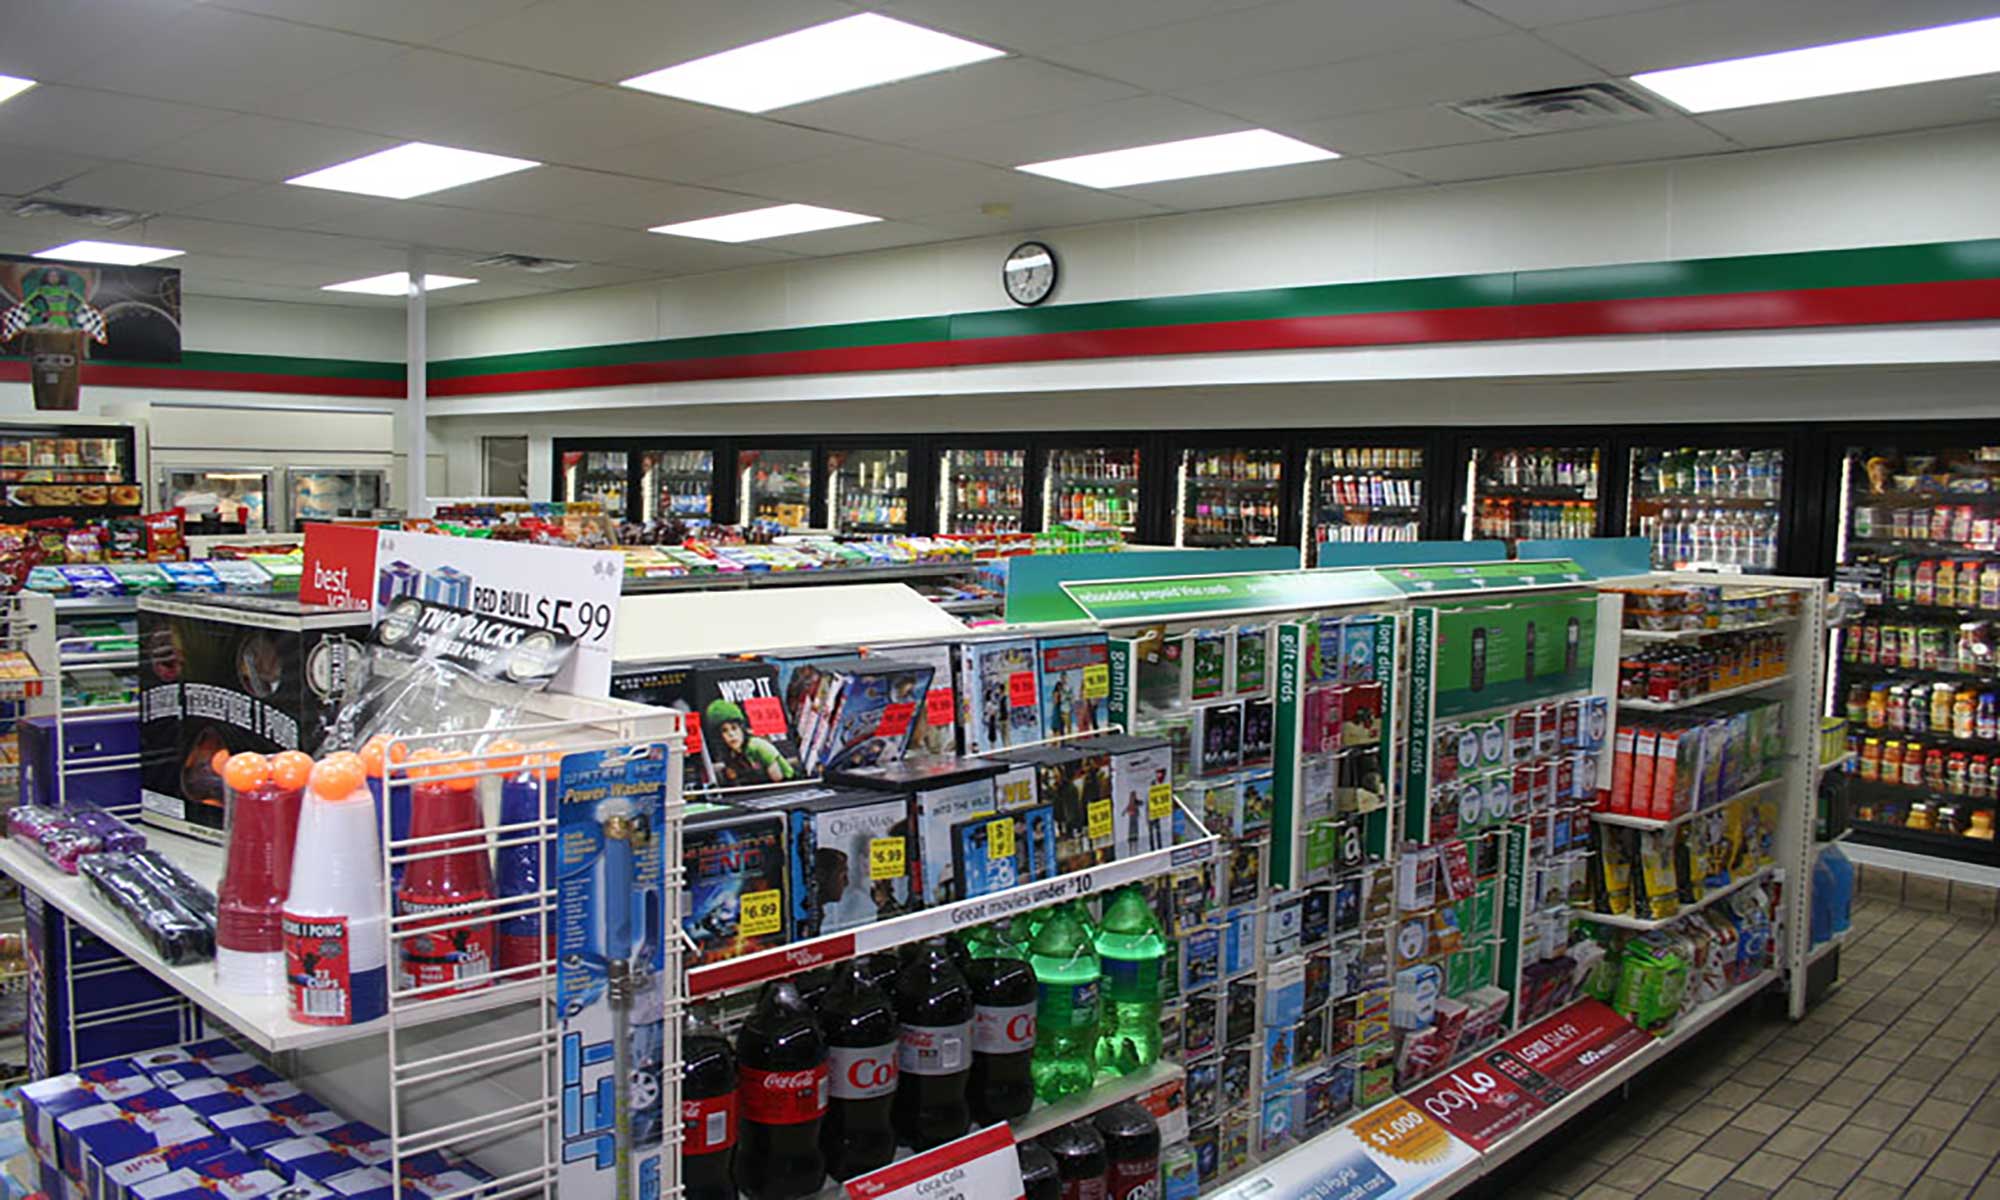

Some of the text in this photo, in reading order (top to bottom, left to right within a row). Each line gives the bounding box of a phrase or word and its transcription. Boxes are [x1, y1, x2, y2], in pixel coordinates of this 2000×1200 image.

[314, 560, 348, 592] best
[327, 589, 369, 610] value
[474, 587, 530, 618] RED BULL
[418, 607, 526, 650] TWO RACKS
[463, 643, 499, 664] PONG
[1280, 634, 1297, 702] gift cards
[1376, 624, 1394, 712] long dist
[756, 677, 773, 697] IT
[1111, 651, 1126, 713] gaming
[1413, 676, 1427, 724] phones
[1413, 727, 1425, 737] &
[1411, 740, 1424, 775] cards
[563, 780, 659, 804] Power Washer
[951, 873, 1093, 924] Great movies under $10
[310, 923, 343, 938] PONG
[1370, 1111, 1424, 1147] $1,000
